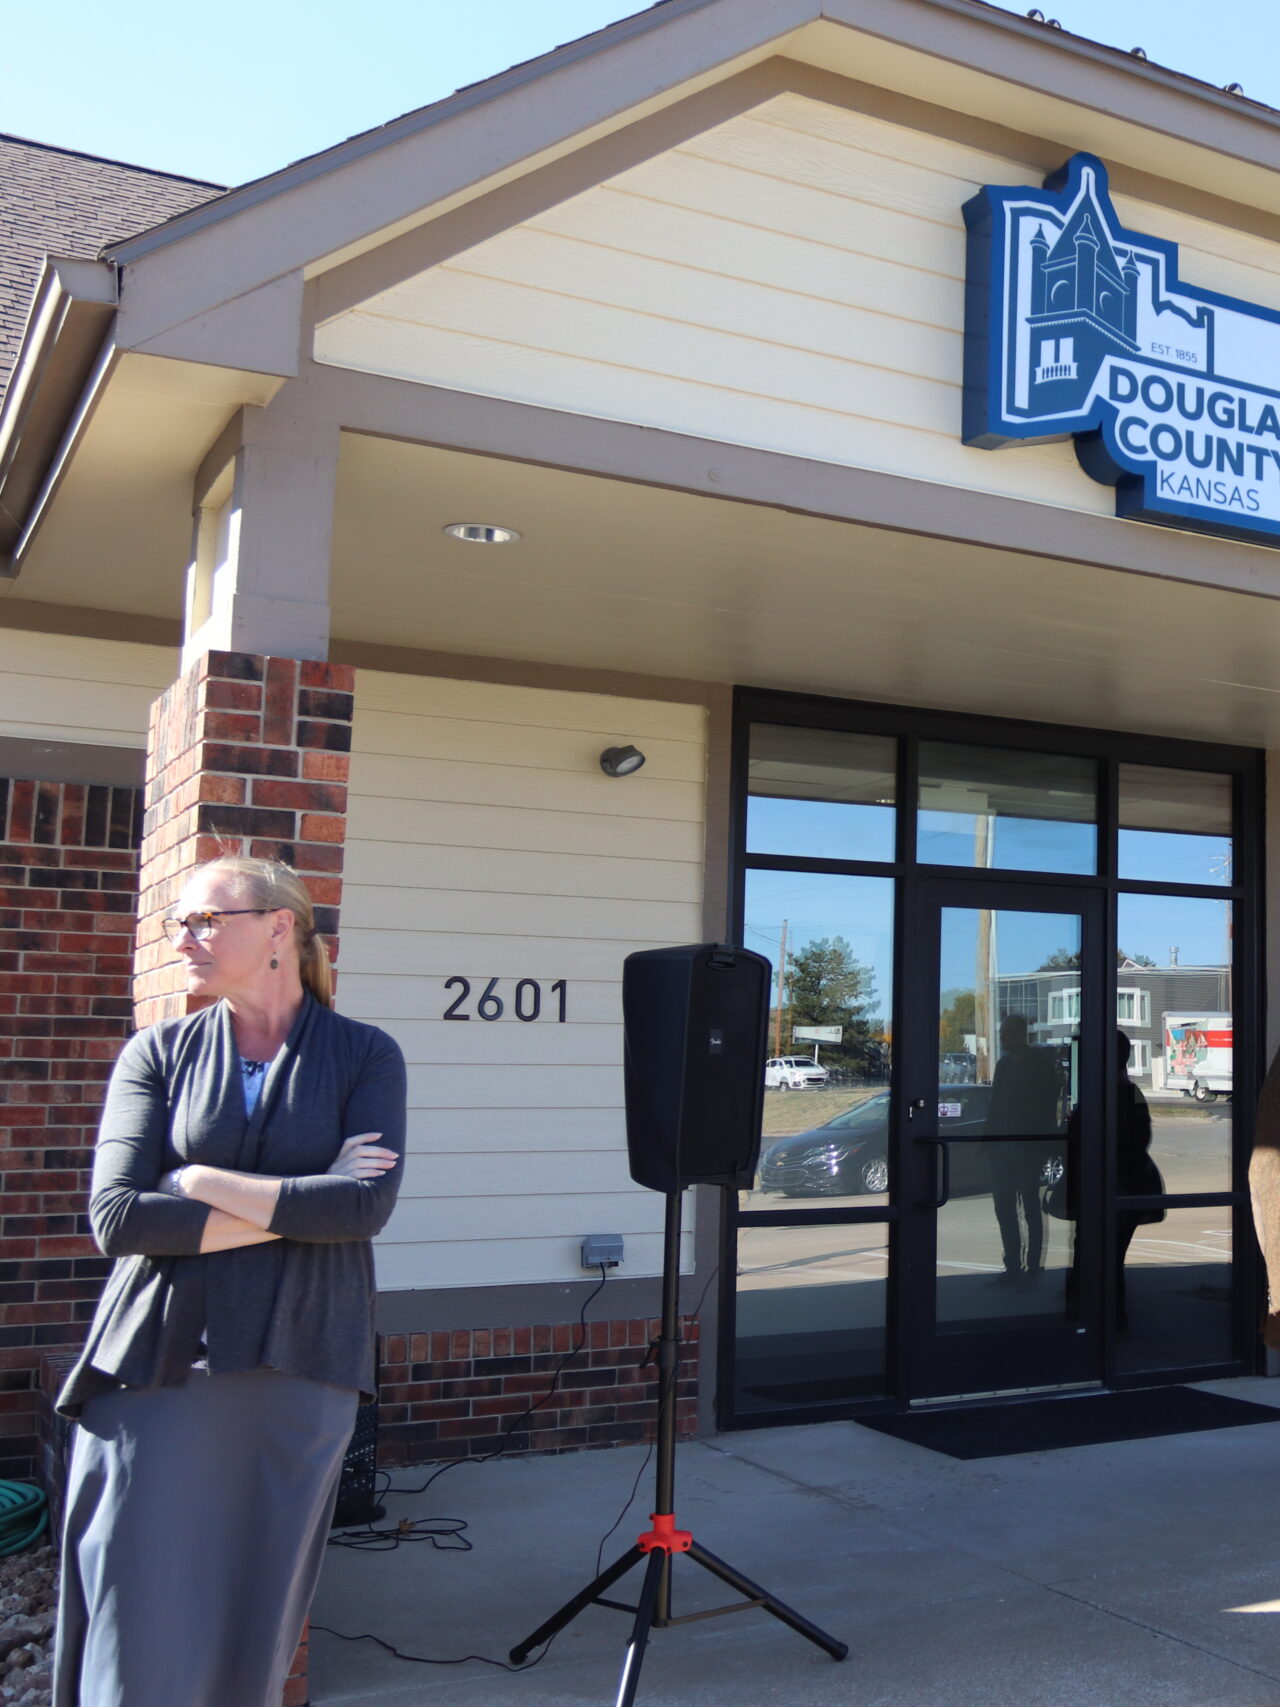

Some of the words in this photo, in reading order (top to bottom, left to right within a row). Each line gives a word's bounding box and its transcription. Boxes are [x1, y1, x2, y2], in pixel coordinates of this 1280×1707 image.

[1175, 348, 1198, 363] 1855
[1160, 469, 1260, 511] KANSAS
[443, 976, 567, 1022] 2601
